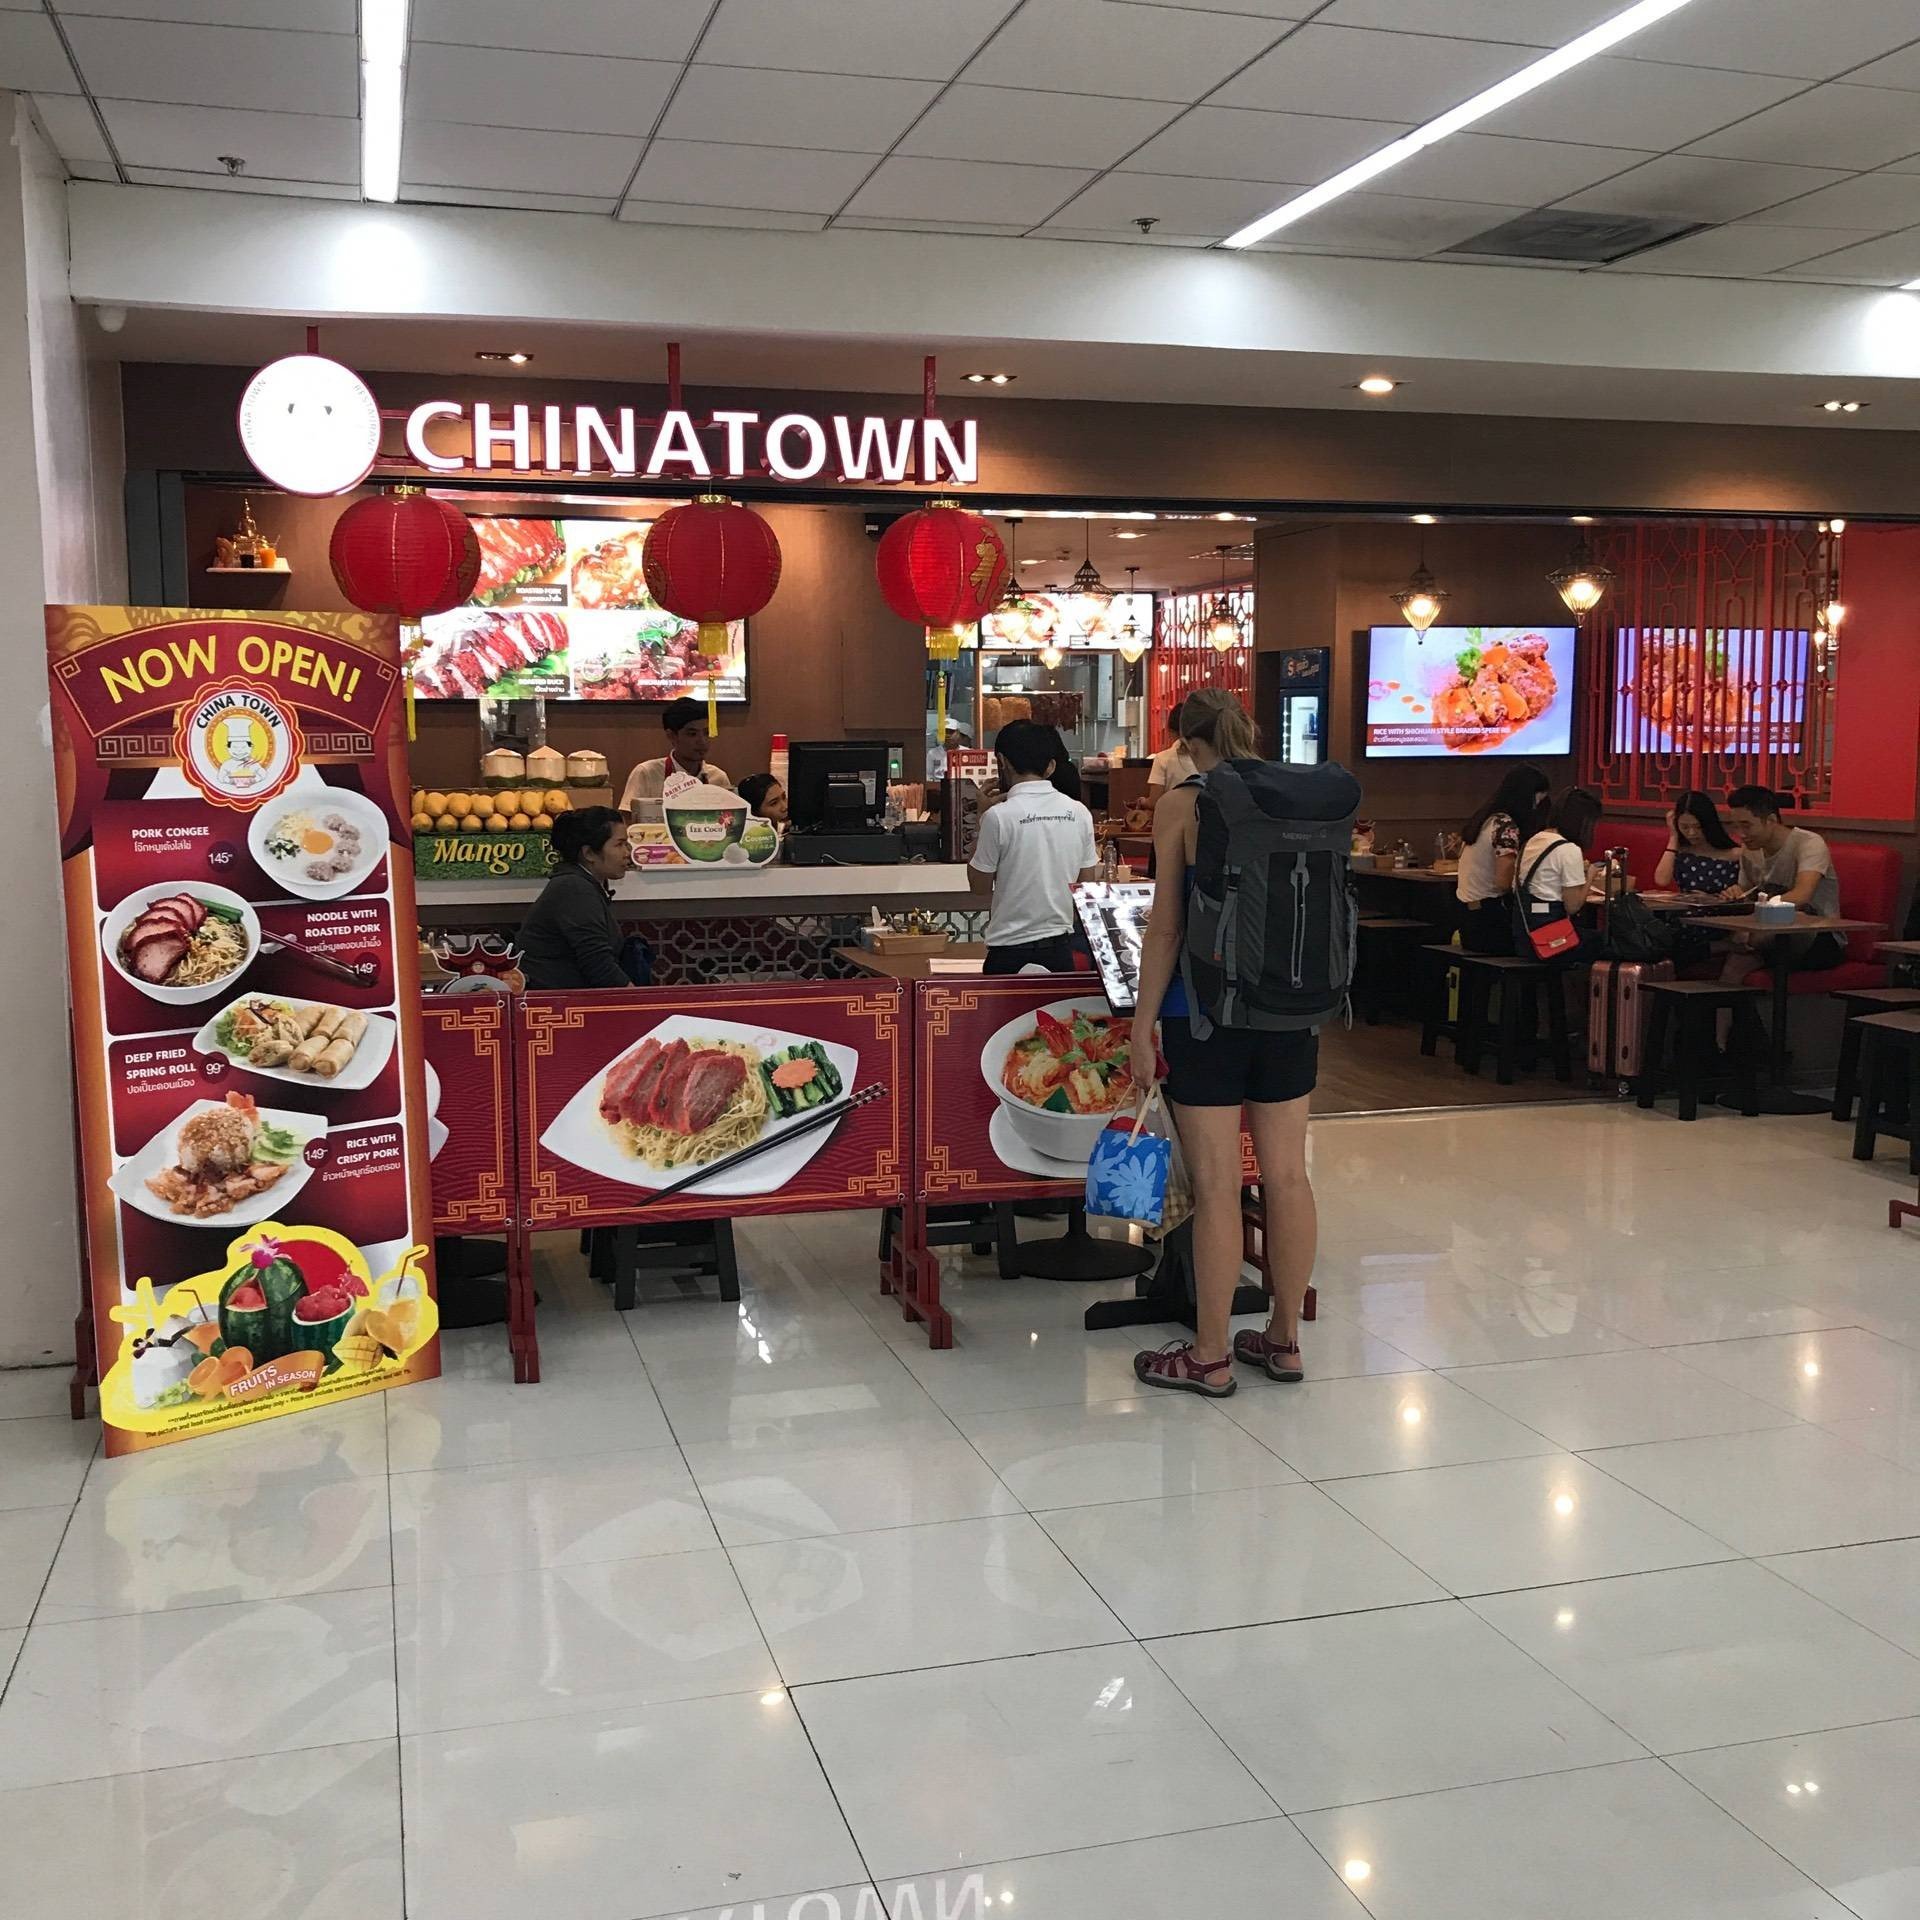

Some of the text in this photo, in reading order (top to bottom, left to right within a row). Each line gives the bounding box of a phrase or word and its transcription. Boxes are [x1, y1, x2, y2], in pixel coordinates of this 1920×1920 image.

[405, 401, 978, 484] CHINATOWN
[99, 635, 361, 704] NOW OPEN!
[196, 695, 281, 729] CHINA TOWN
[684, 779, 696, 787] FREE
[131, 826, 210, 838] PORK CONGEE
[433, 838, 525, 875] Mango
[306, 909, 377, 922] NOODLE WITH
[305, 923, 381, 937] ROASTED PORK
[124, 1048, 186, 1064] DEEP FRIED
[126, 1063, 197, 1079] SPRING ROLL
[346, 1134, 397, 1149] RICE WITH
[336, 1148, 400, 1165] CRISPY PORK
[230, 1365, 277, 1396] FRUITS
[265, 1380, 275, 1389] IN
[277, 1371, 316, 1384] SEASON
